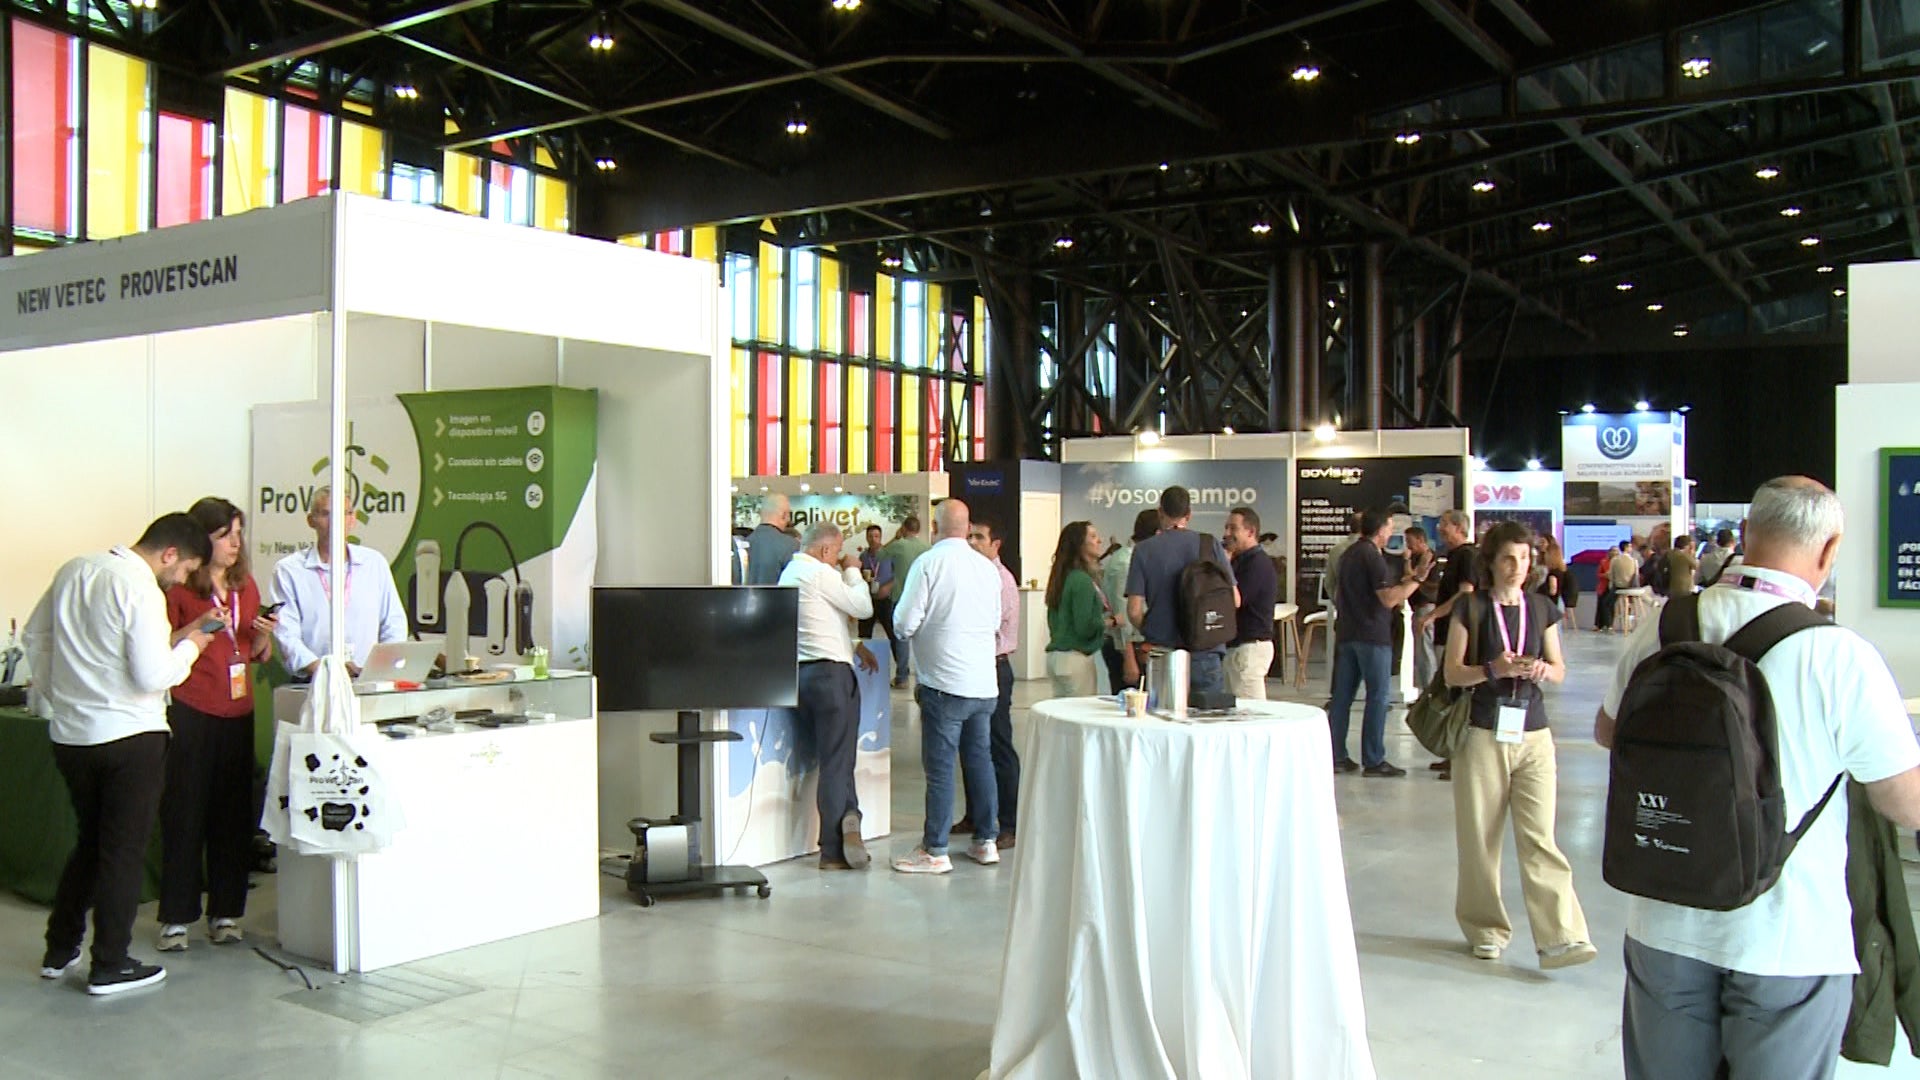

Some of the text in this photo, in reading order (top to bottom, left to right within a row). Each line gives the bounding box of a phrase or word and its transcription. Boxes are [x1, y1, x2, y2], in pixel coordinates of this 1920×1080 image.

[17, 254, 238, 314] NEW VETEC PROVETSCAN
[449, 414, 491, 426] Imagen en
[448, 428, 493, 438] dispositivo
[485, 457, 497, 467] sin
[498, 457, 523, 467] cables
